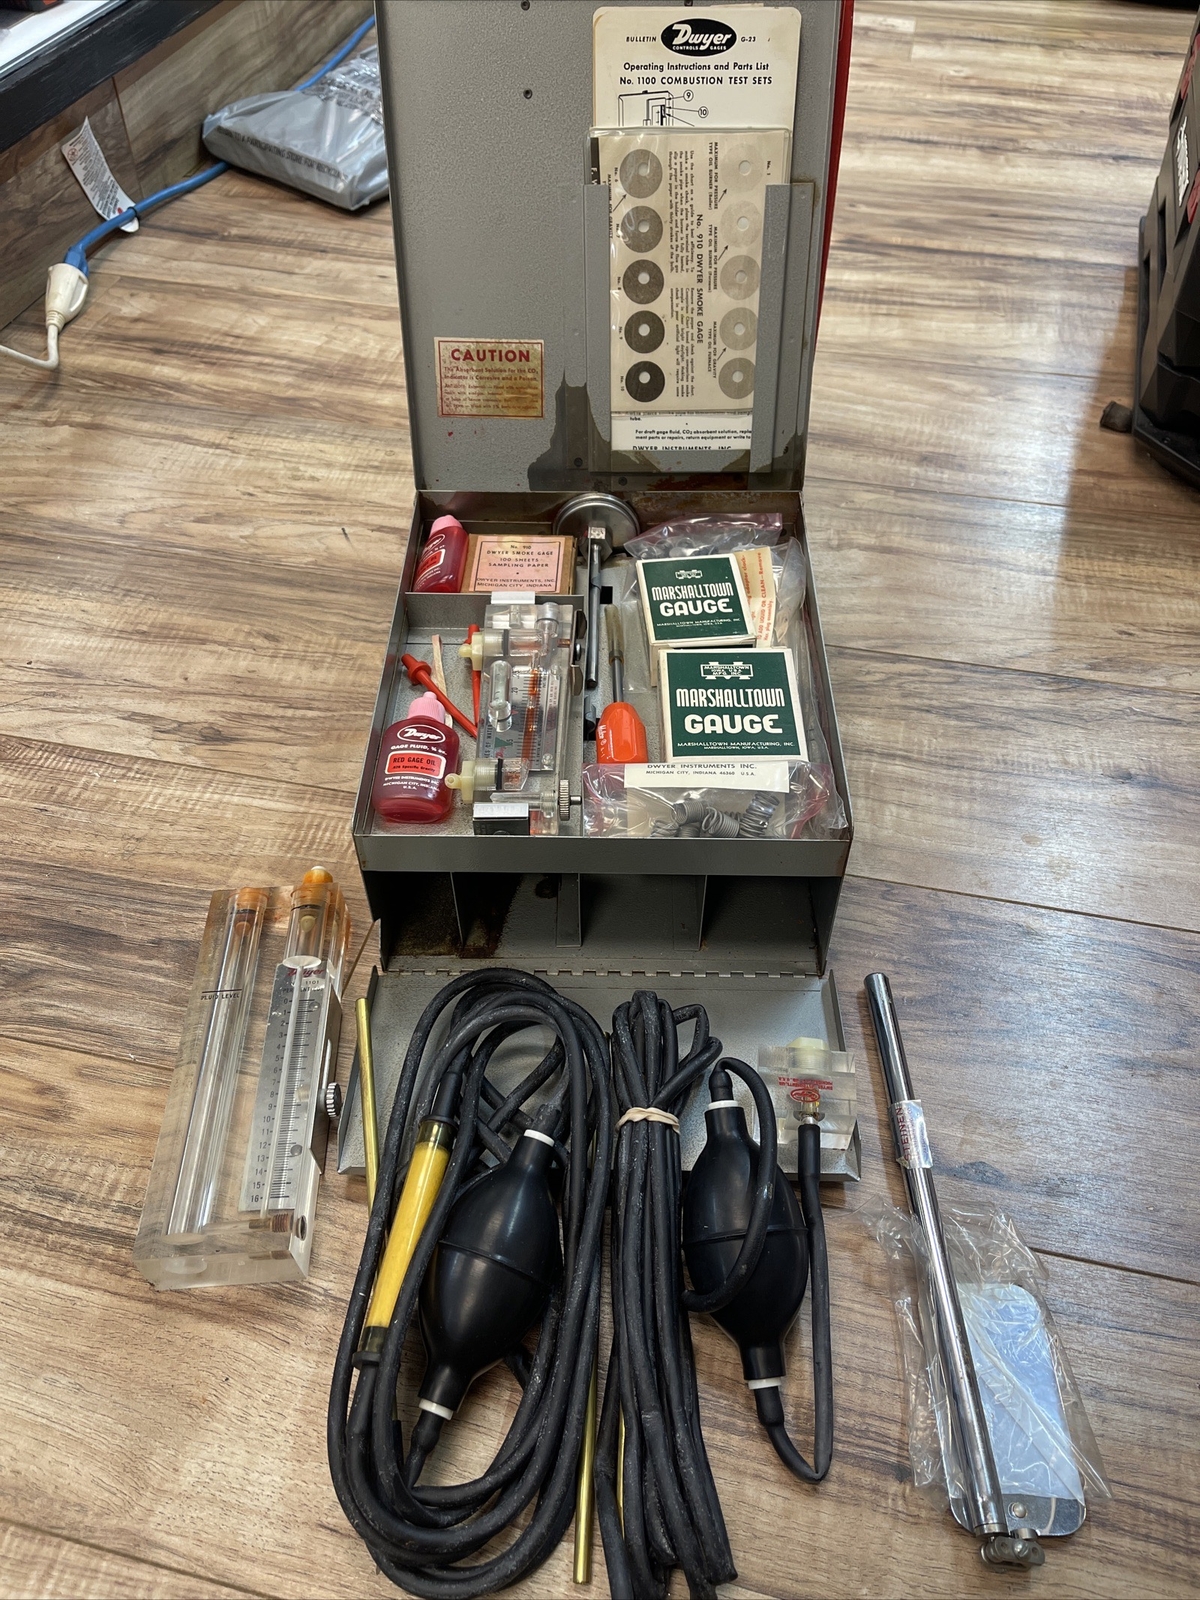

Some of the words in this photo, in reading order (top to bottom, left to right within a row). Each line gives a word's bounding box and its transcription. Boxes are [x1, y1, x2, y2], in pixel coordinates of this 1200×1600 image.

[672, 23, 732, 50] Dwyer
[624, 62, 664, 72] Operating
[667, 62, 711, 71] Instructions
[714, 62, 729, 71] and
[733, 62, 752, 71] Parts
[756, 62, 769, 71] List
[451, 349, 530, 362] CAUTION
[652, 582, 734, 601] MARSHALLTOWN
[660, 598, 733, 617] GAUGE
[676, 688, 785, 708] MARSHALLTOWN
[403, 728, 441, 739] Dwyer
[684, 714, 783, 734] GAUGE
